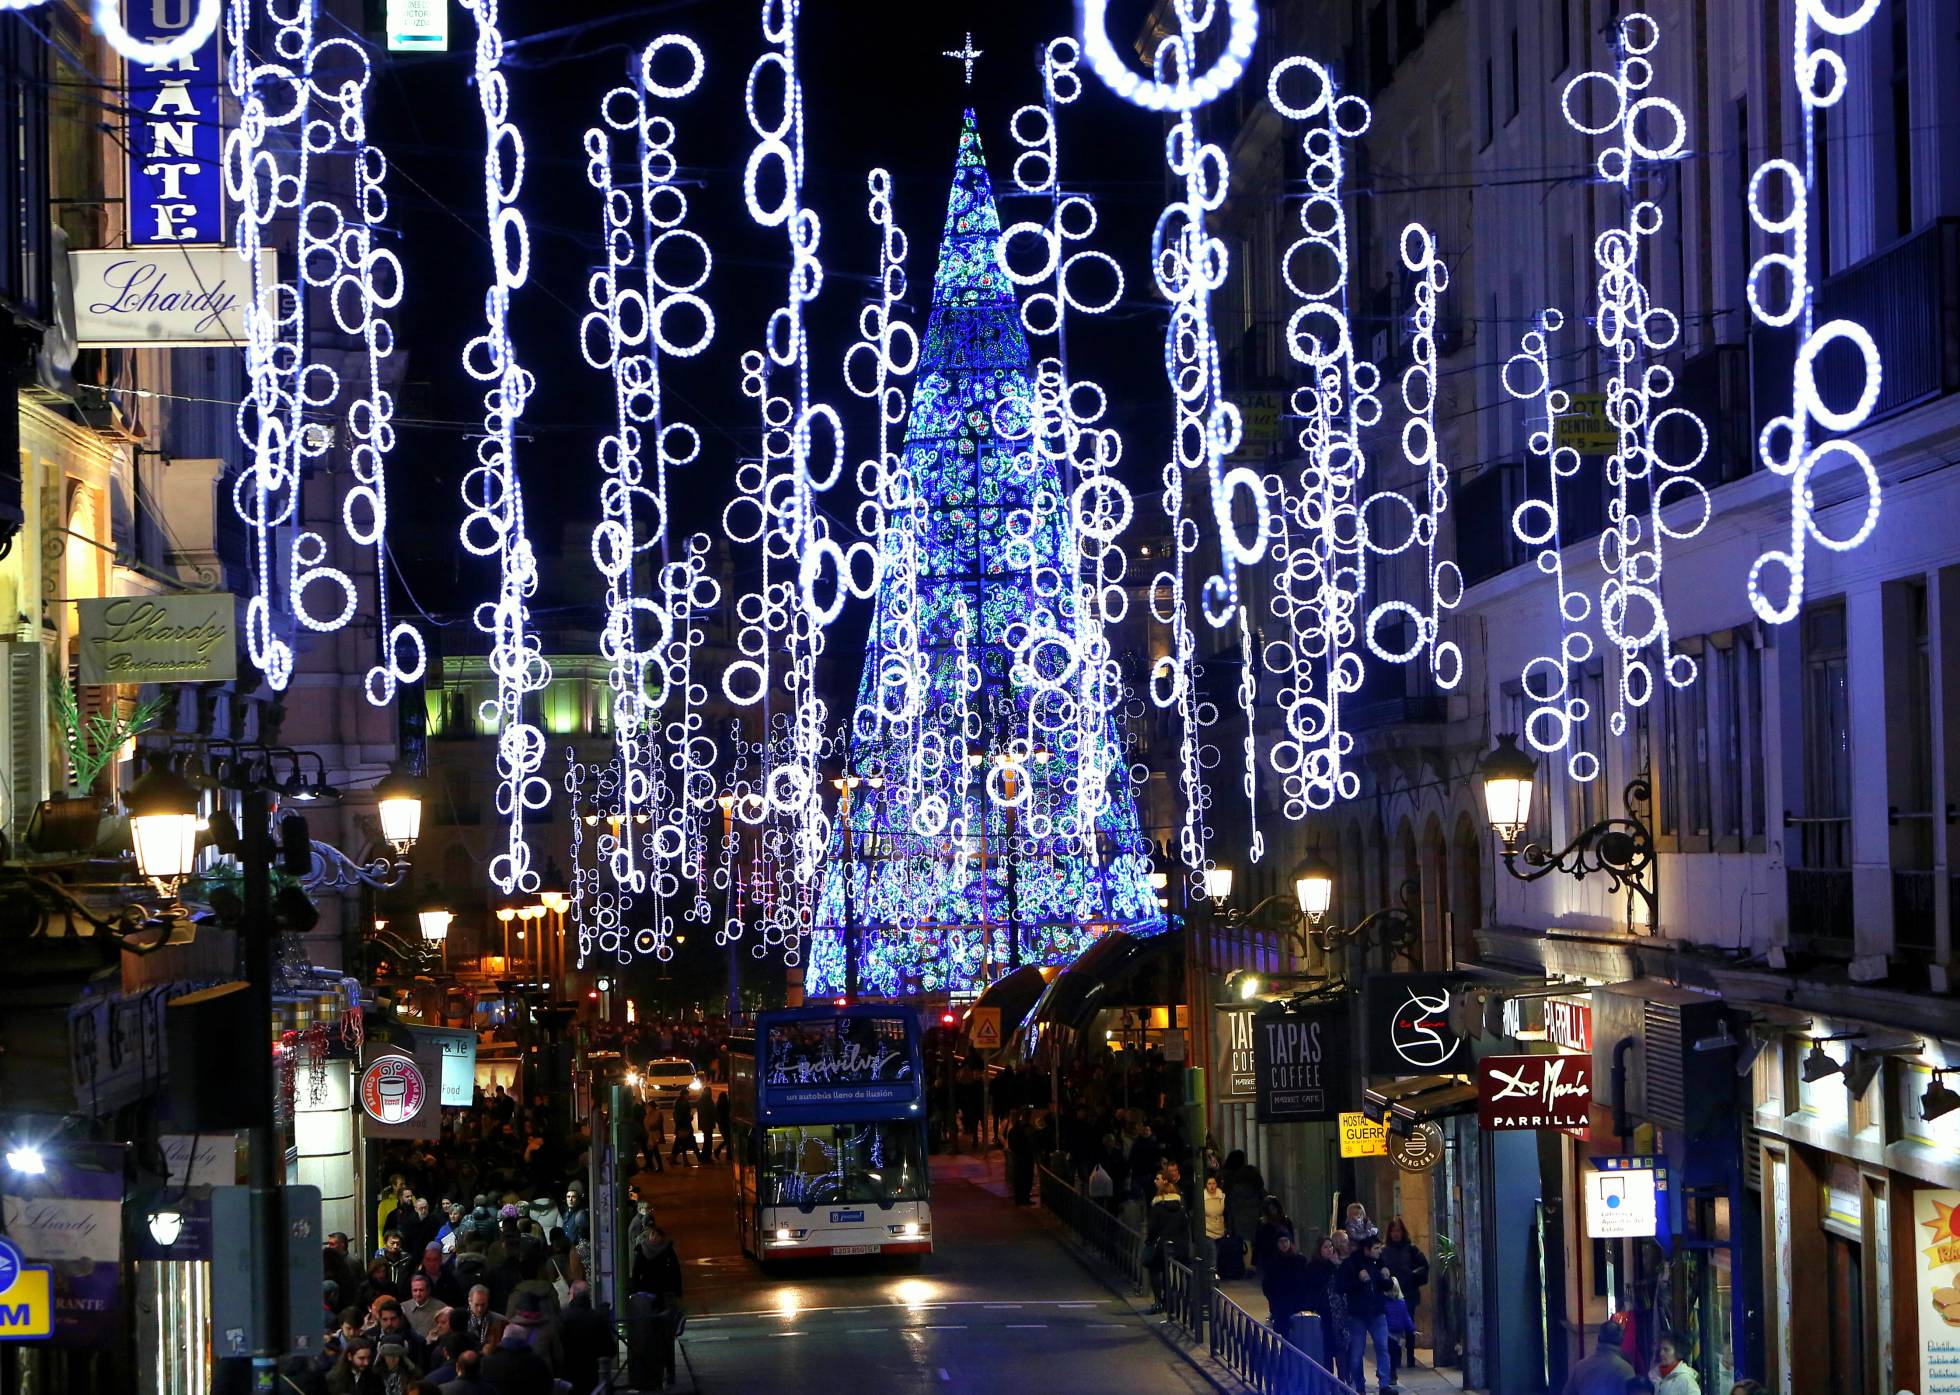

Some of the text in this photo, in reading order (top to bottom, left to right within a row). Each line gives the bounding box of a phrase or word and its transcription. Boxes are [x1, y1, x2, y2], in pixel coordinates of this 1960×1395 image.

[89, 260, 240, 333] Lhardy
[91, 599, 226, 654] Lhardy
[1543, 1000, 1586, 1051] PARRILLA
[456, 1040, 469, 1054] Té
[1266, 1022, 1322, 1064] TAPAS
[1271, 1064, 1321, 1088] COFFEE
[798, 1091, 832, 1100] autobús
[833, 1090, 855, 1099] lleno
[855, 1090, 865, 1098] de
[865, 1089, 894, 1098] ilusión
[1274, 1095, 1299, 1104] MARKET
[1343, 1115, 1369, 1127] HOSTAL
[1493, 1115, 1589, 1127] PARRILLA
[1397, 1152, 1435, 1167] BURGERS
[780, 1221, 790, 1229] 15
